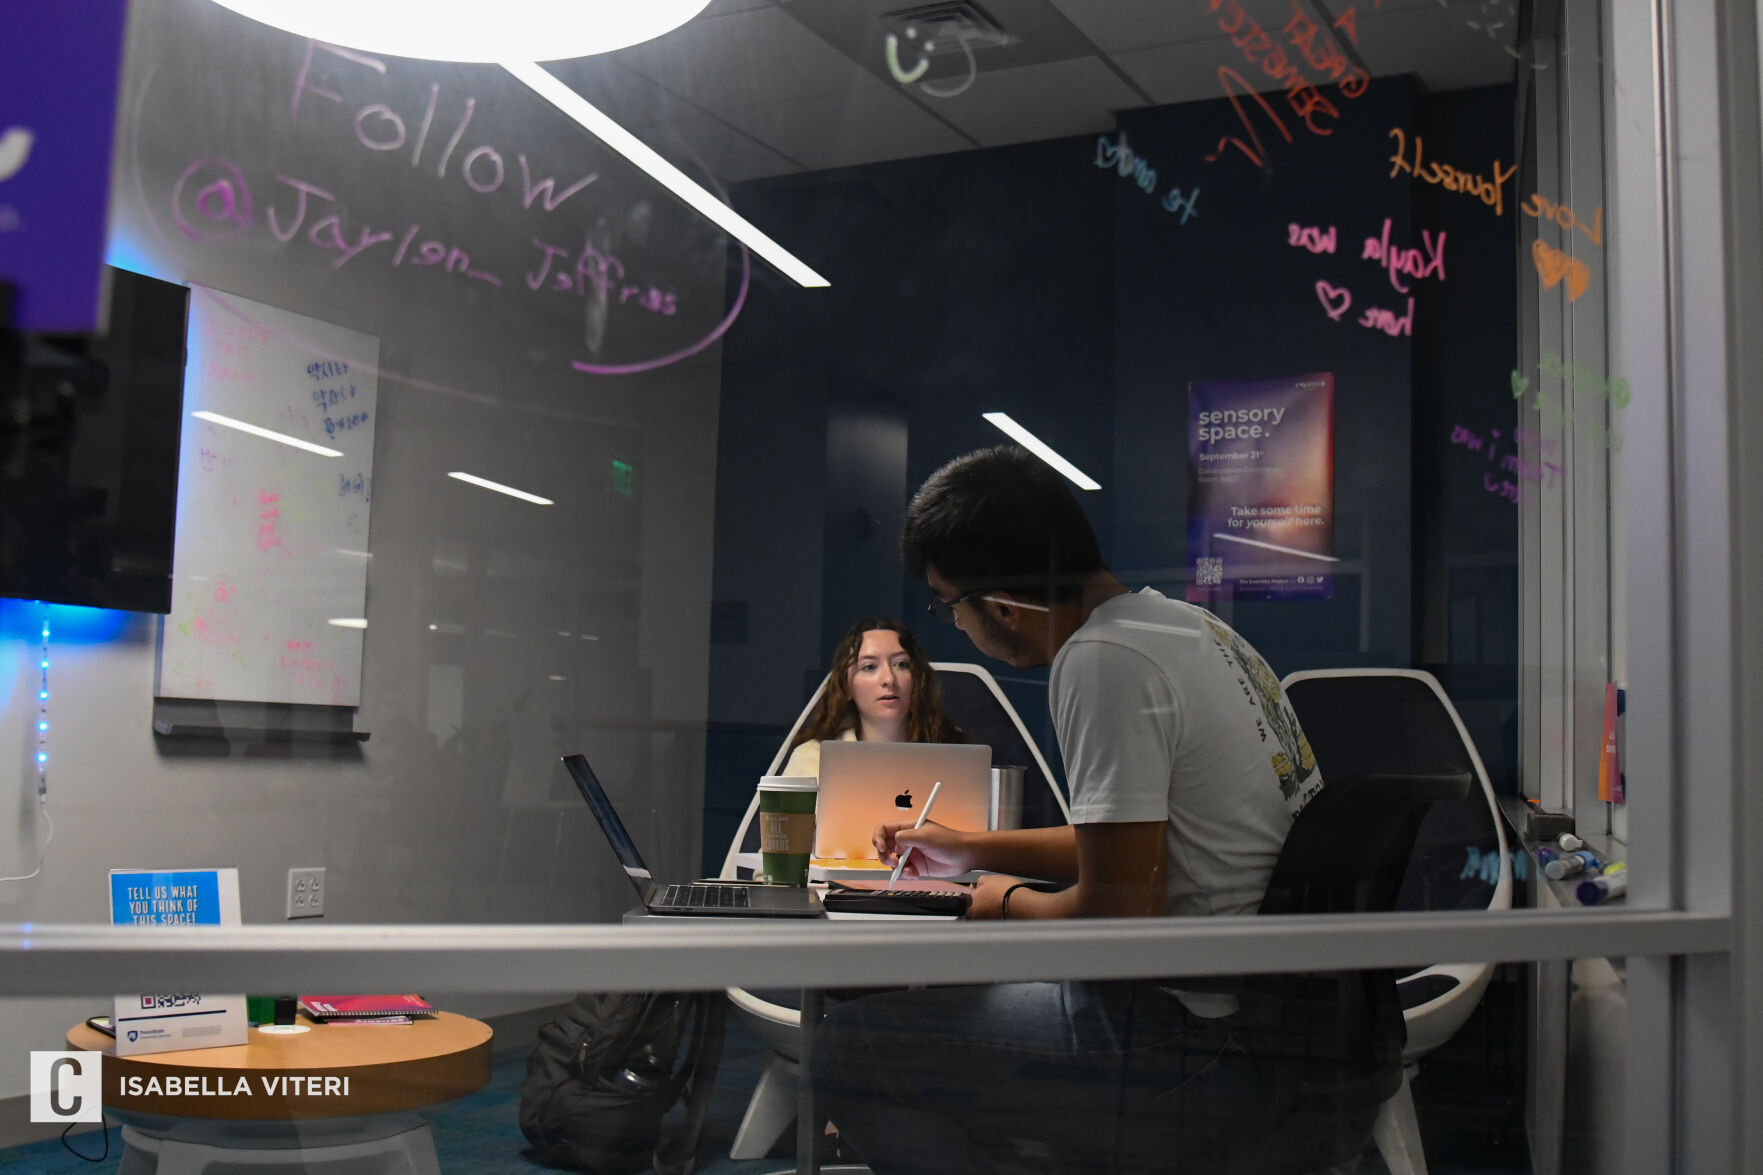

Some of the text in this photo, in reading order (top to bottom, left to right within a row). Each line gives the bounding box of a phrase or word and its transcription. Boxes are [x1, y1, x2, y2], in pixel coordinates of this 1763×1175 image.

[293, 38, 599, 212] Follow
[1199, 407, 1286, 426] sensory
[1199, 425, 1270, 445] space.
[1199, 451, 1249, 462] September
[1230, 504, 1322, 517] Take some time
[1228, 516, 1325, 530] for yourself here.
[1237, 676, 1257, 706] ARE
[1255, 718, 1267, 743] WE
[770, 821, 782, 833] ALL
[128, 885, 198, 901] TELL US WHAT
[129, 899, 198, 914] YOU THINK OF
[133, 912, 197, 927] THIS SPACE!
